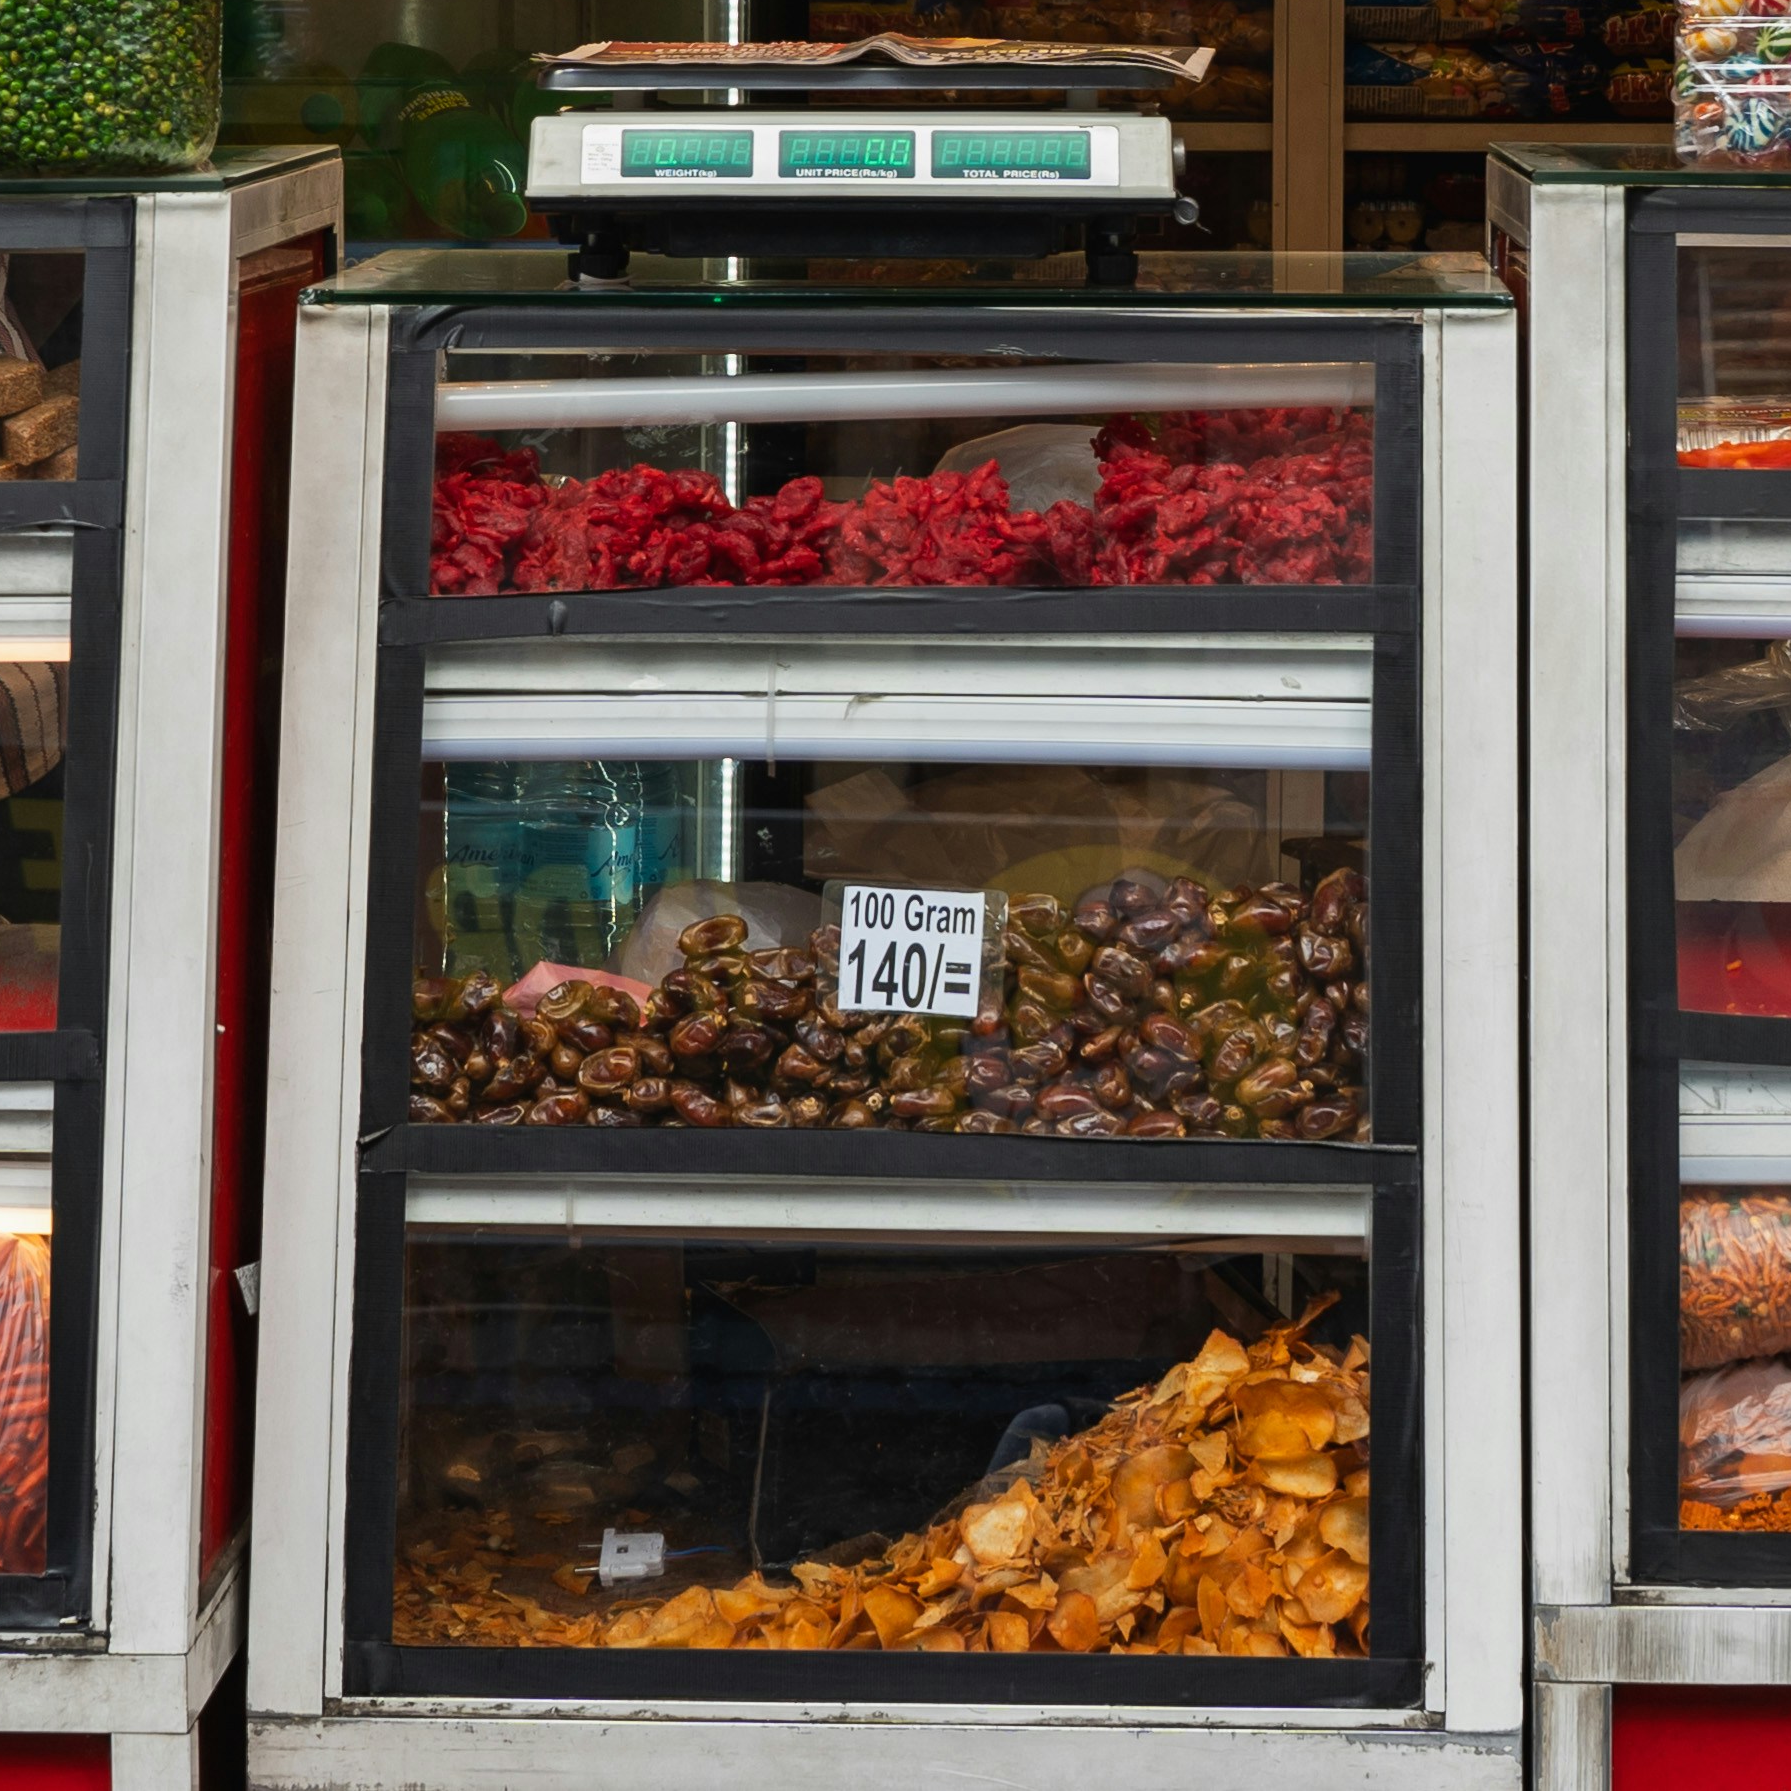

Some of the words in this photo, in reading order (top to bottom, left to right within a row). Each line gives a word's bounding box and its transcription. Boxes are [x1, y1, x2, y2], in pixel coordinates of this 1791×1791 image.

[654, 168, 717, 178] WEIGHT(kg)
[796, 168, 823, 178] UNIT
[824, 168, 898, 179] PRICE(Rs/kg)
[962, 169, 999, 178] TOTAL
[1003, 169, 1060, 179] PRICE(Rs)
[851, 891, 895, 929] 100
[905, 894, 975, 934] Gram
[848, 939, 972, 1009] 140/=
